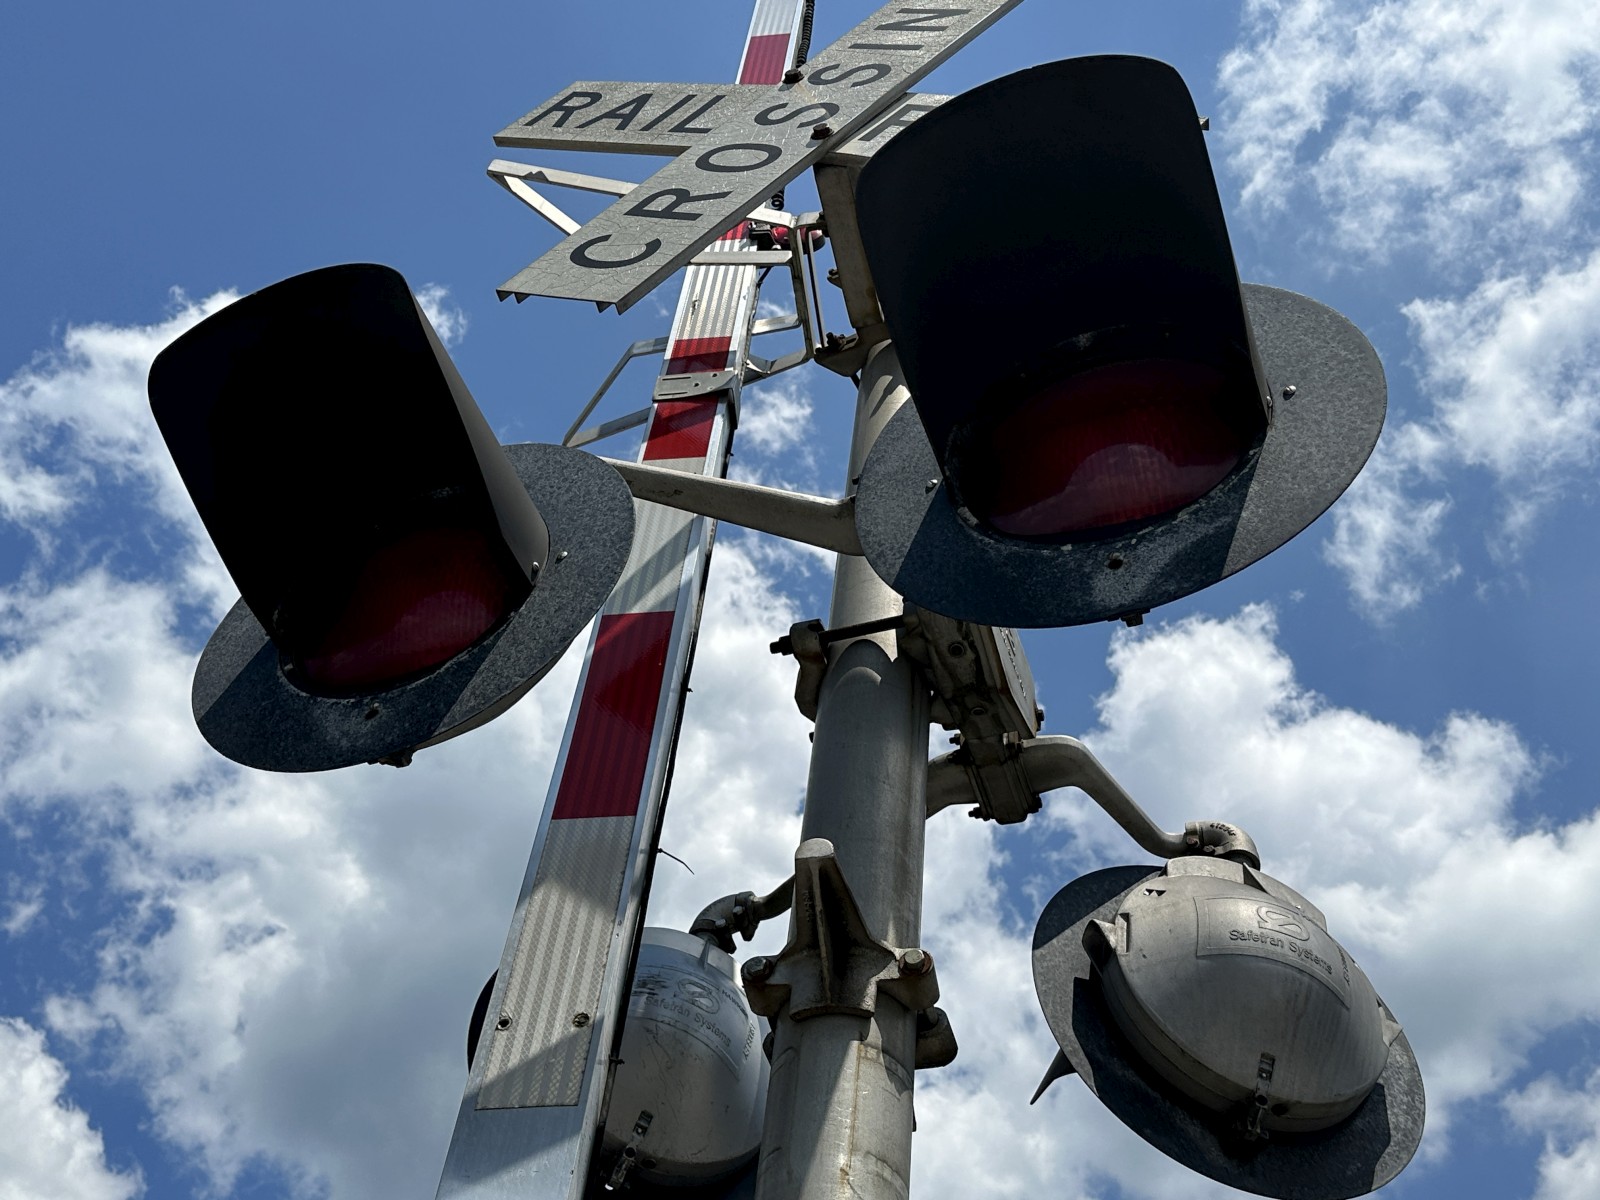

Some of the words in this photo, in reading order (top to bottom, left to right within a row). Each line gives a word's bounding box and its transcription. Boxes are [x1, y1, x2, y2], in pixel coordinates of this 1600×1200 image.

[523, 90, 726, 134] RAIL
[1229, 929, 1284, 949] Safetran
[1289, 941, 1333, 975] Systems
[645, 996, 690, 1018] Safetran
[694, 1013, 732, 1048] Systems
